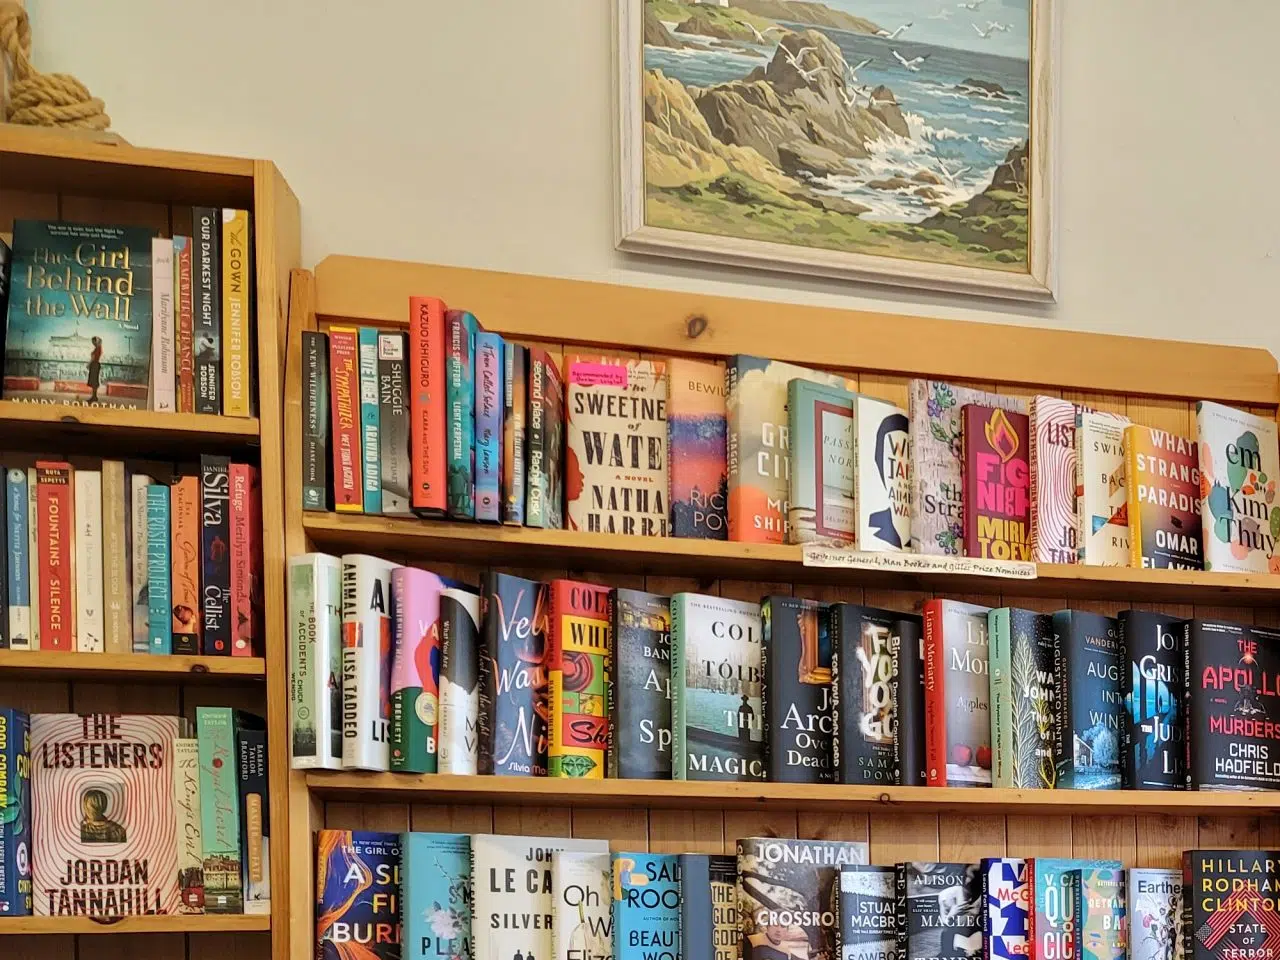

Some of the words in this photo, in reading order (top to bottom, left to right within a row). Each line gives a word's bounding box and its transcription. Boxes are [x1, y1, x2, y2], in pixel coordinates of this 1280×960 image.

[201, 216, 210, 240] OUR
[75, 243, 130, 270] Girl
[201, 243, 211, 287] DARKEST
[229, 247, 242, 293] GOWN
[26, 265, 135, 297] Behind
[25, 295, 65, 318] the
[70, 294, 131, 323] Wall
[202, 289, 212, 327] NIGHT
[420, 303, 428, 337] KAZUO
[229, 297, 241, 357] JENNIFER
[230, 360, 241, 400] ROBSON
[420, 340, 430, 387] ISHIGURO
[532, 360, 541, 399] second
[381, 375, 391, 404] BAIN
[391, 363, 403, 416] SHUGGIE
[532, 402, 543, 429] place
[1226, 443, 1262, 472] em
[203, 472, 222, 527] Silva
[233, 475, 244, 512] Refuge
[1225, 486, 1269, 520] Kim
[48, 497, 60, 566] FOUNTAINS
[1156, 530, 1198, 556] OMAR
[1218, 517, 1278, 559] Thúy
[883, 558, 901, 566] Man
[903, 559, 930, 569] Booker
[932, 561, 948, 570] and
[973, 564, 993, 573] Prize
[49, 579, 61, 630] SILENCE
[344, 563, 357, 619] ANIMAL
[204, 585, 220, 631] Cellist
[925, 610, 933, 645] Liane
[1237, 639, 1258, 654] THE
[343, 651, 354, 682] LISA
[925, 647, 935, 692] Moriarty
[78, 714, 123, 740] THE
[344, 684, 357, 738] TADDEO
[42, 742, 163, 770] LISTENERS
[1229, 742, 1269, 760] CHRIS
[60, 859, 149, 886] JORDAN
[913, 874, 964, 886] ALISON
[44, 888, 168, 917] TANNAHILL
[1228, 924, 1267, 934] STATE
[1242, 936, 1255, 945] OF
[1222, 949, 1274, 958] TERROR
